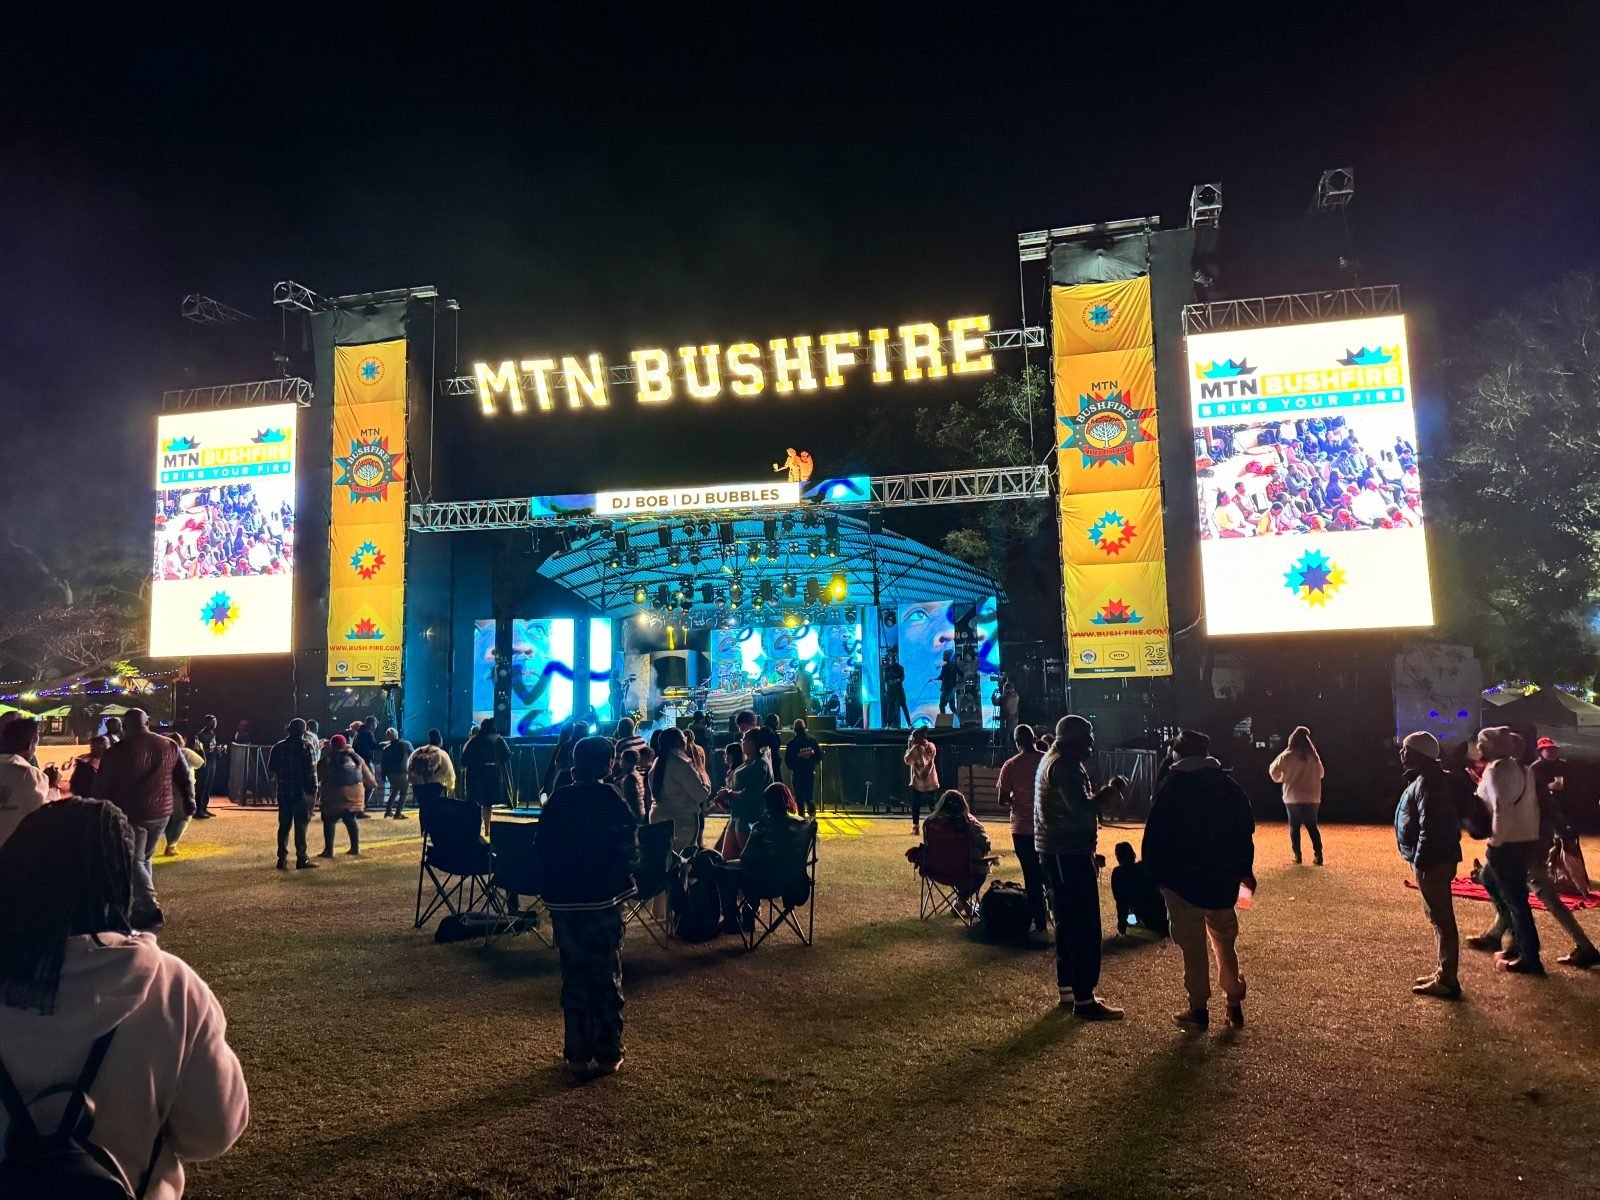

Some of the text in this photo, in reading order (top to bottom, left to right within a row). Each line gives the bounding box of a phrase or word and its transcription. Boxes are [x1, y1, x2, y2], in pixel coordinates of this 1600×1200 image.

[1095, 311, 1108, 319] 17
[474, 315, 994, 414] MTN BUSHFIRE
[1091, 380, 1118, 391] MTN
[1201, 365, 1400, 399] MTN BUSHFIRE
[1076, 401, 1134, 423] BUSHFIRE
[1201, 389, 1400, 417] BRING YOUR FIRE
[360, 428, 380, 436] MTN
[164, 444, 290, 468] MTN BUSHFIRE
[347, 445, 390, 464] BUSHFIRE
[213, 466, 249, 477] YOUR
[612, 488, 780, 508] DJ BOB DJ BUBBLES
[1071, 628, 1168, 638] WWW.BUSH-FIRE.COM
